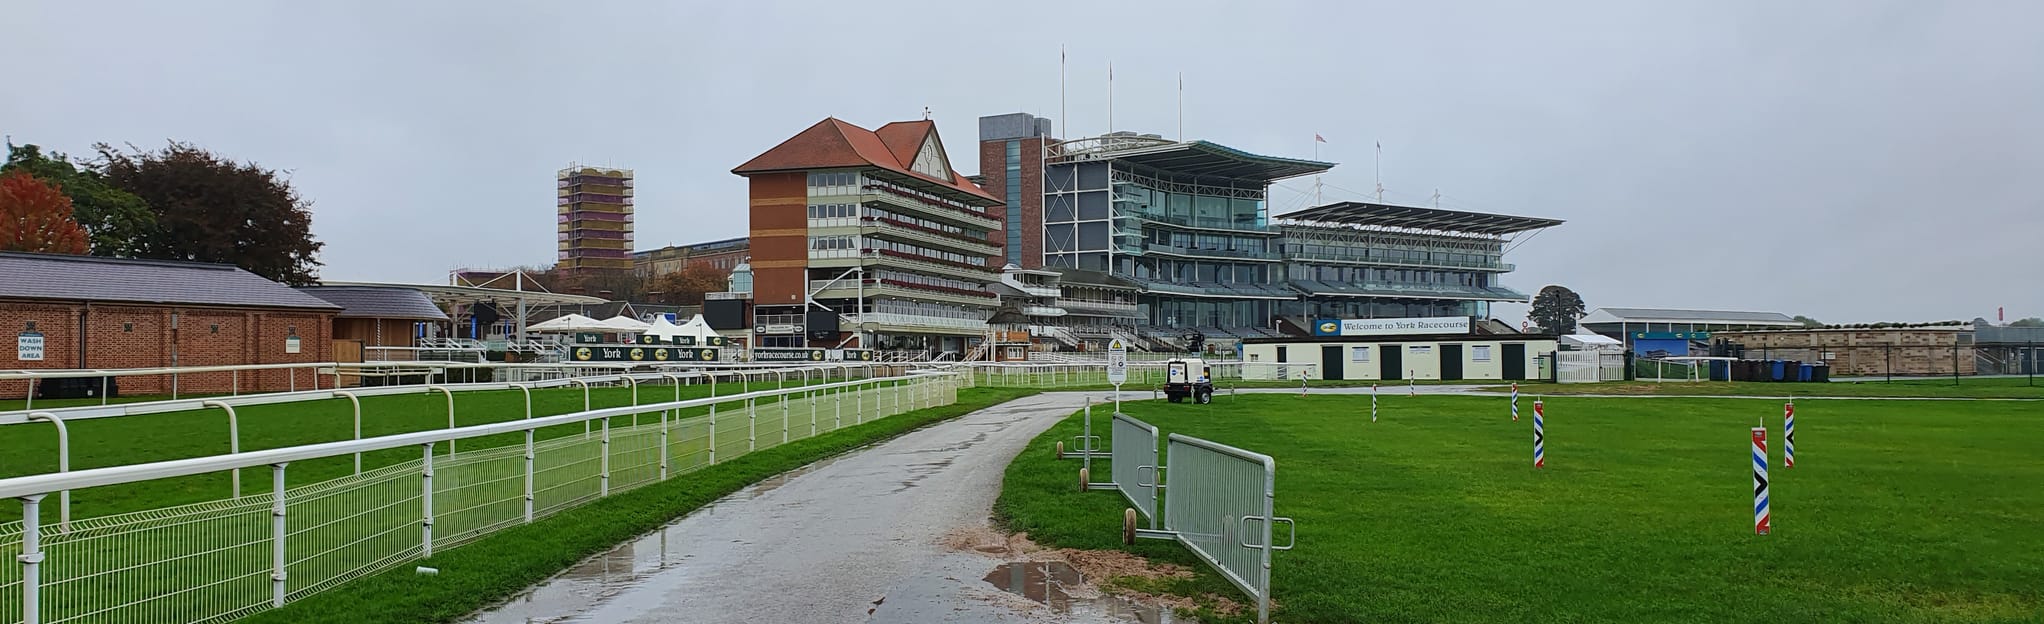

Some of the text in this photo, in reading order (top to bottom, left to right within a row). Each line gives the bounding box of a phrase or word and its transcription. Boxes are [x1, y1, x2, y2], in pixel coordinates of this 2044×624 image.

[583, 335, 597, 343] York
[603, 348, 621, 359] York
[677, 348, 694, 359] York
[754, 351, 809, 360] yorkracecourse.co.uk
[846, 351, 857, 359] York
